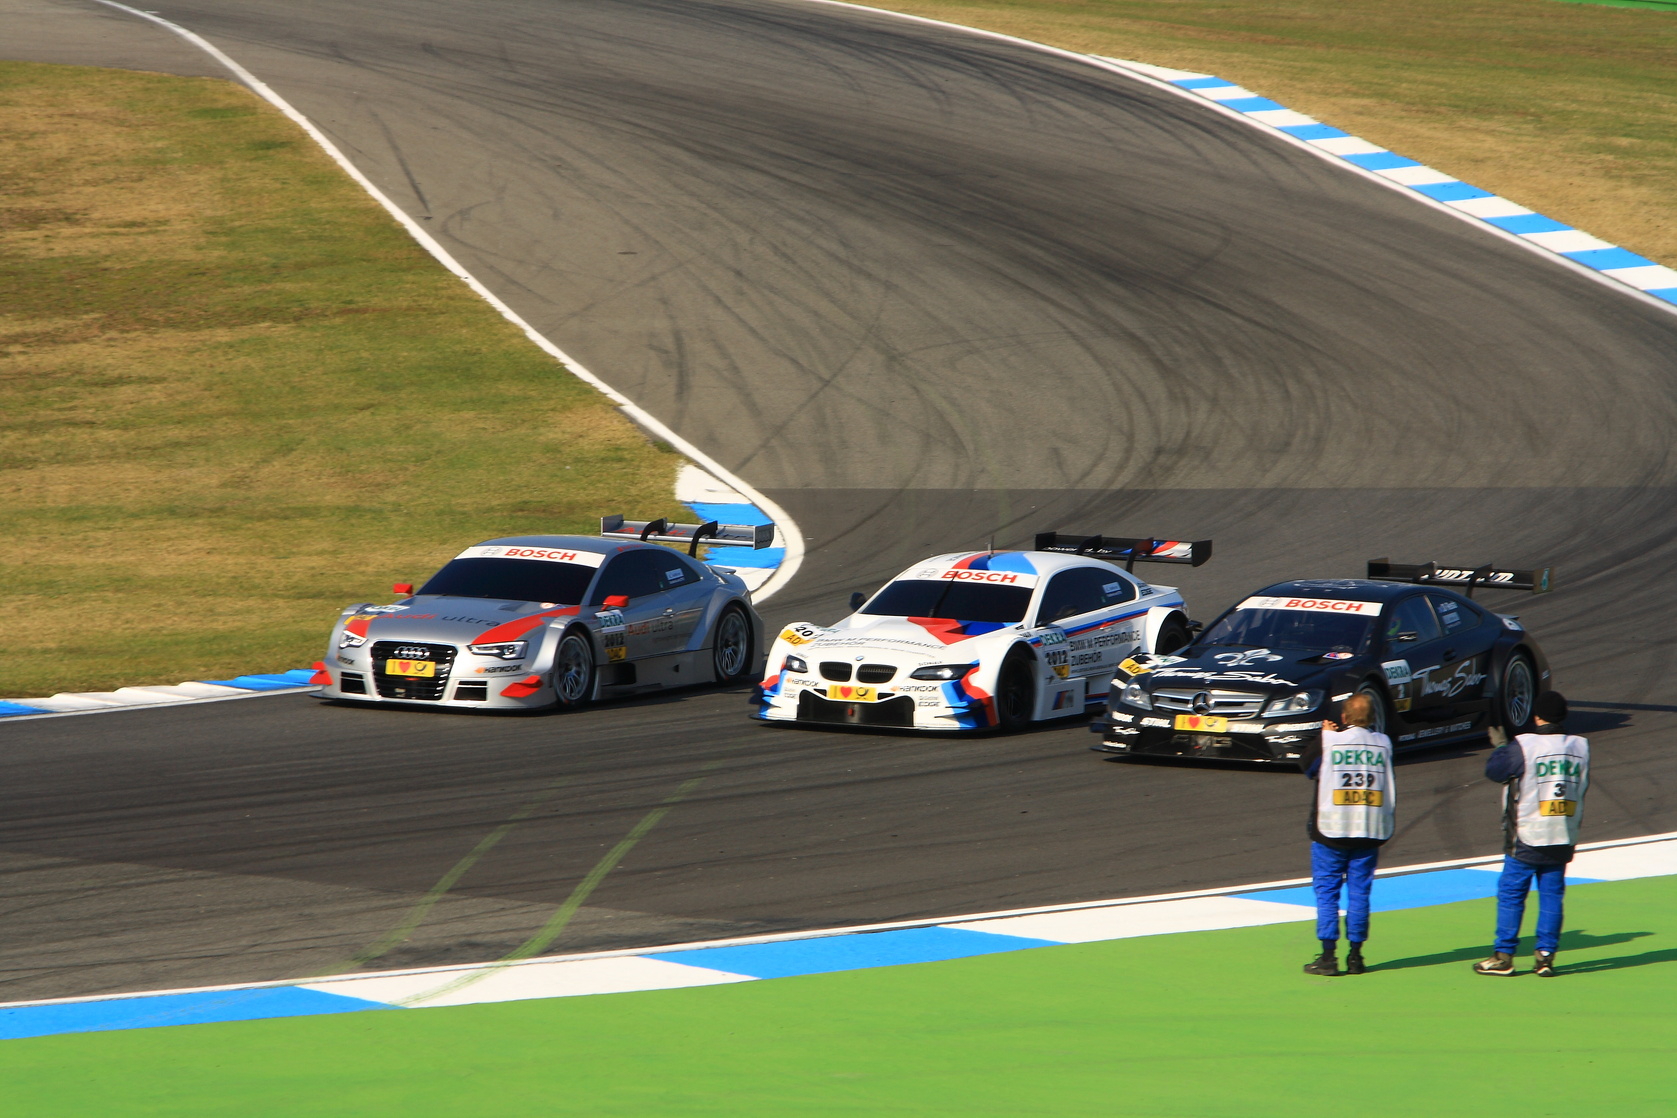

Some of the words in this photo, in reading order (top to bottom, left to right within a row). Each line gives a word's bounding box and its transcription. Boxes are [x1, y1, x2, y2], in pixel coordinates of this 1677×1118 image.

[504, 548, 577, 561] BOSCH
[941, 571, 1018, 583] BOSCH
[1284, 599, 1364, 612] BOSCH
[442, 615, 502, 627] ultra
[1332, 749, 1386, 767] DEKRA
[1536, 759, 1581, 777] DEKRA
[1342, 772, 1376, 787] 239
